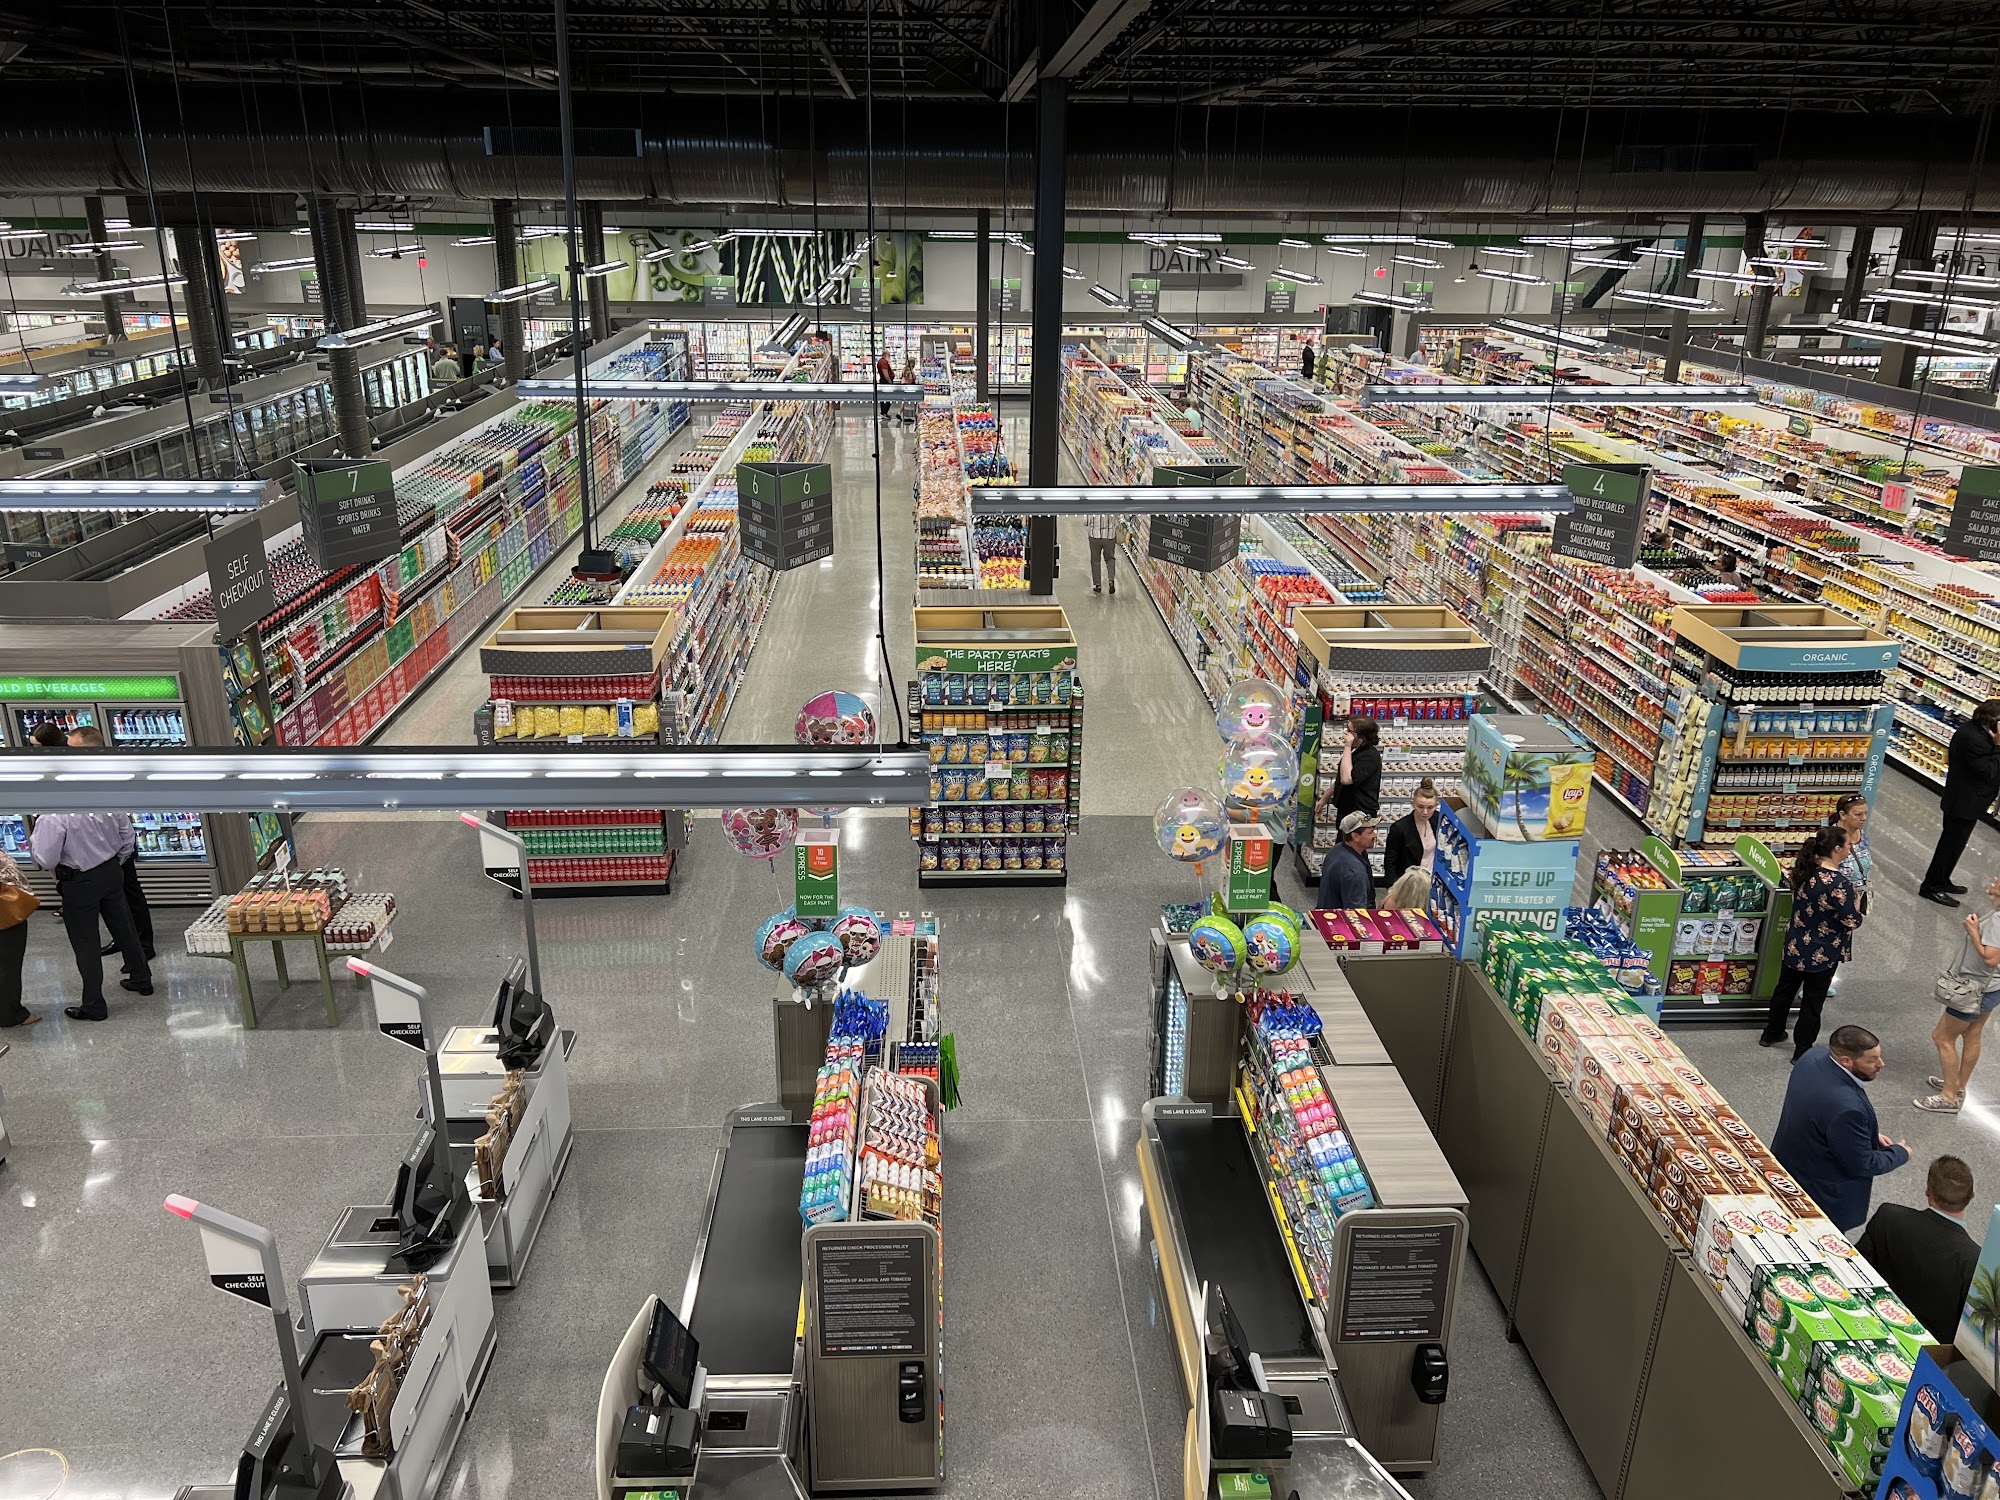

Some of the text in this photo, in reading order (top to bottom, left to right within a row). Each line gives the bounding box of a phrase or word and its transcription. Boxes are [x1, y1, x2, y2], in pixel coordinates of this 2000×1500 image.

[1149, 247, 1230, 273] DAIRY
[347, 470, 358, 493] 7
[752, 473, 759, 494] 6
[803, 473, 811, 494] 6
[1593, 473, 1605, 495] 4
[338, 494, 376, 510] SOFT DRINKS
[1884, 485, 1906, 510] EXIT
[1982, 498, 2000, 509] CAKE
[1591, 499, 1626, 514] VEGETABLES
[336, 507, 381, 525] SPORTS DRINKS
[801, 512, 815, 523] CANDY
[1167, 514, 1189, 528] CRACKERS
[1586, 511, 1603, 523] PASTA
[351, 523, 371, 536] WATER
[809, 523, 820, 536] FRUIT
[1171, 527, 1183, 539] NUTS
[1569, 521, 1616, 540] RICE/DRY BEANS
[1967, 522, 2000, 536] SALAD DR
[804, 538, 815, 550] JUICE
[1162, 538, 1191, 554] POTATO CHIPS
[1569, 534, 1611, 551] SAUCES/MIXES
[26, 550, 42, 558] PIZZA
[1167, 552, 1184, 564] SNACKS
[1560, 544, 1616, 566] STUFFING/POTATOES
[227, 553, 249, 580] SELF
[219, 569, 265, 609] CHECKOUT
[944, 649, 1050, 660] THE PARTY STARTS
[1802, 653, 1848, 662] ORGANIC
[977, 659, 1017, 673] HERE!
[26, 682, 106, 694] BEVERAGES
[1698, 756, 1711, 793] ORGANIC
[1864, 754, 1879, 792] ORGANIC
[1563, 787, 1584, 800] Lay's
[816, 848, 824, 856] 10
[1253, 842, 1261, 850] 10
[797, 846, 806, 880] EXPRESS
[1233, 841, 1243, 875] EXPRESS
[1653, 845, 1671, 869] New.
[1749, 844, 1768, 869] New.
[1491, 871, 1556, 887] STEP UP
[1483, 894, 1557, 905] TO THE TASTES OF
[1600, 957, 1620, 966] UFFLES
[1622, 957, 1650, 967] RUFFLES
[1337, 1191, 1367, 1208] mentos
[807, 1204, 836, 1219] mentos
[224, 1281, 266, 1289] CHECKOUT
[1841, 1364, 1861, 1379] DRY
[254, 1396, 285, 1448] THIS LANE IS CLOSED
